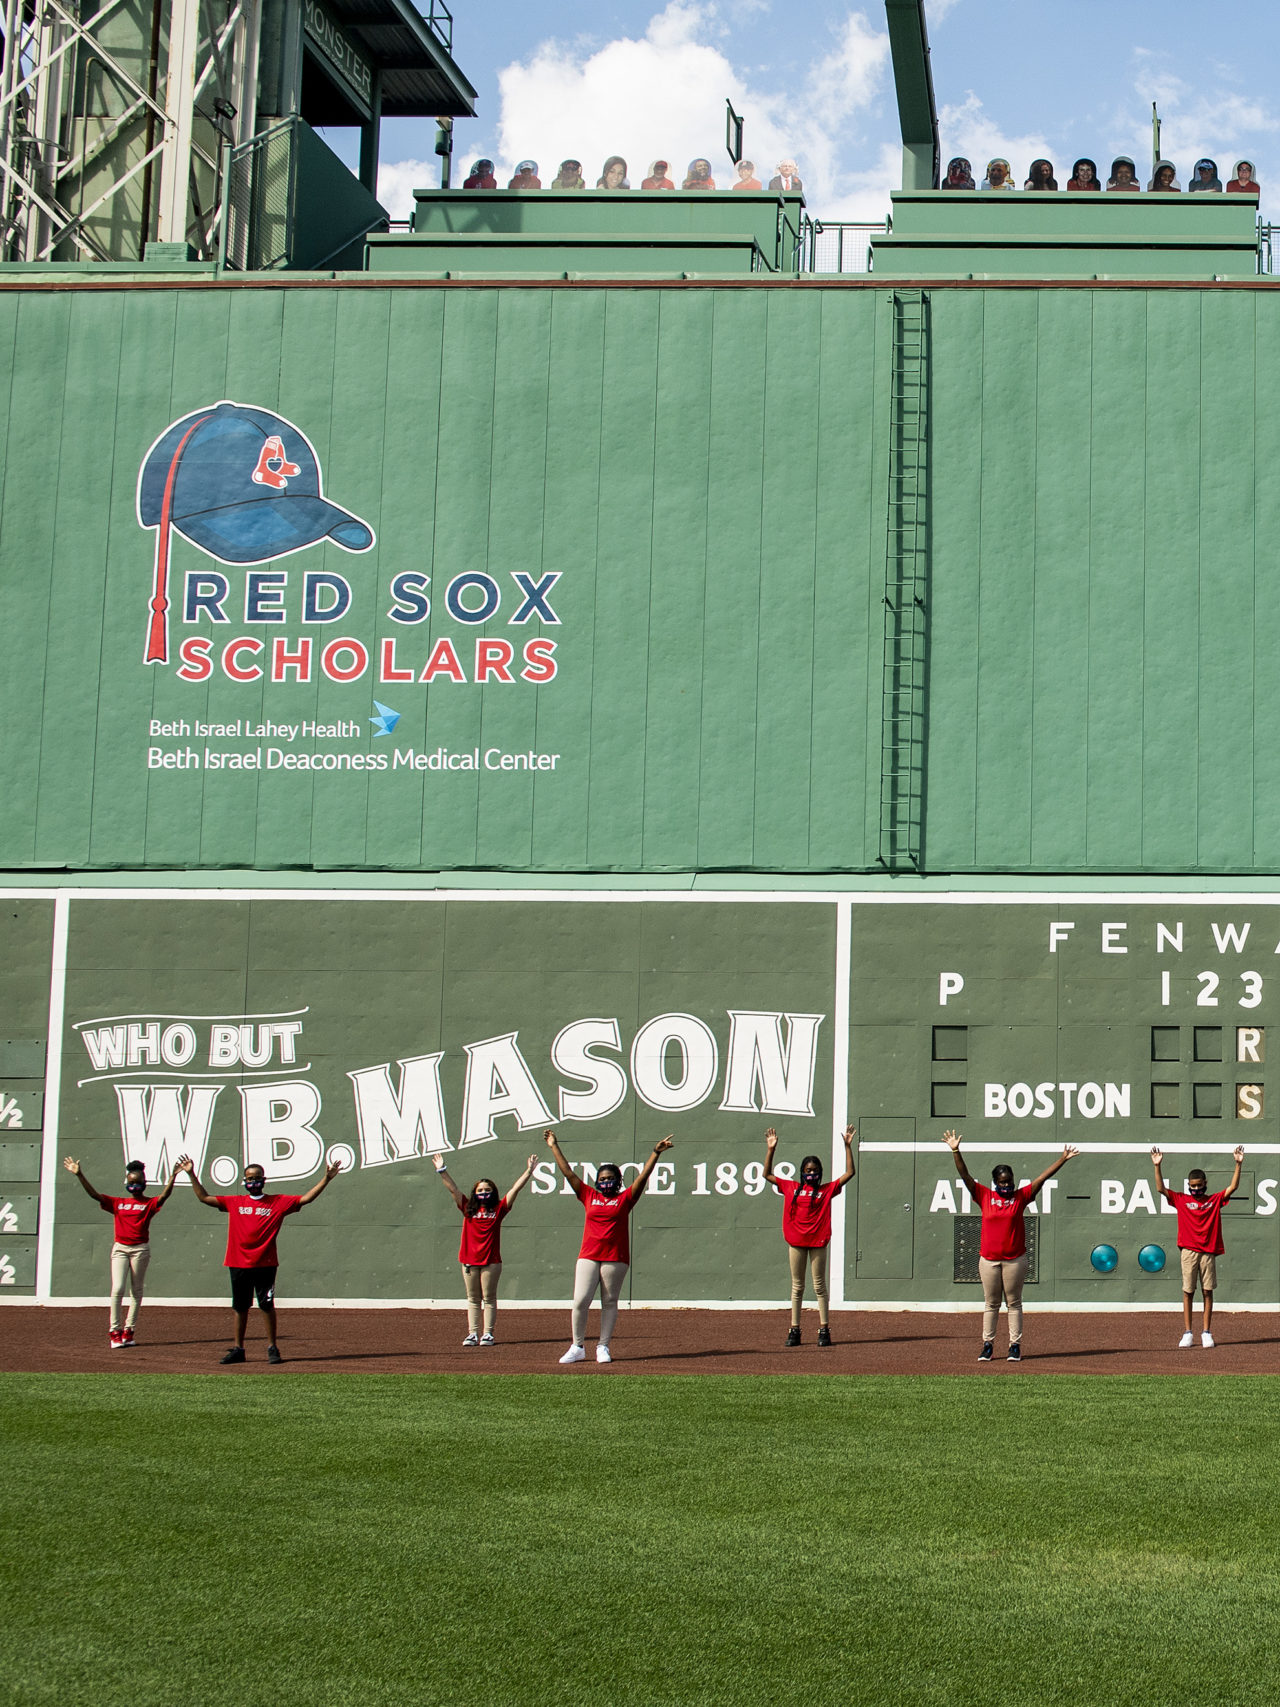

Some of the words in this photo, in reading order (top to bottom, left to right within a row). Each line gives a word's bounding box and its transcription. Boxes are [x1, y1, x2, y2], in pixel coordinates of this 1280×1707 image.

[182, 570, 353, 624] RED
[387, 571, 563, 625] SOX
[175, 637, 559, 684] SCHOLARS
[149, 720, 191, 737] Beth
[194, 720, 242, 737] Israel
[245, 720, 299, 742] Lahey
[302, 720, 361, 738] Health
[147, 747, 200, 770] Beth
[204, 747, 262, 770] Israel
[266, 748, 388, 771] Deaconess
[392, 748, 480, 771] Medical
[484, 748, 561, 771] Center
[939, 972, 964, 1006] P
[1196, 971, 1220, 1007] 2
[1238, 971, 1263, 1008] 3
[82, 1022, 197, 1071] WHO
[208, 1021, 303, 1068] BUT
[984, 1082, 1131, 1118] BOSTON
[691, 1162, 796, 1196] 1898
